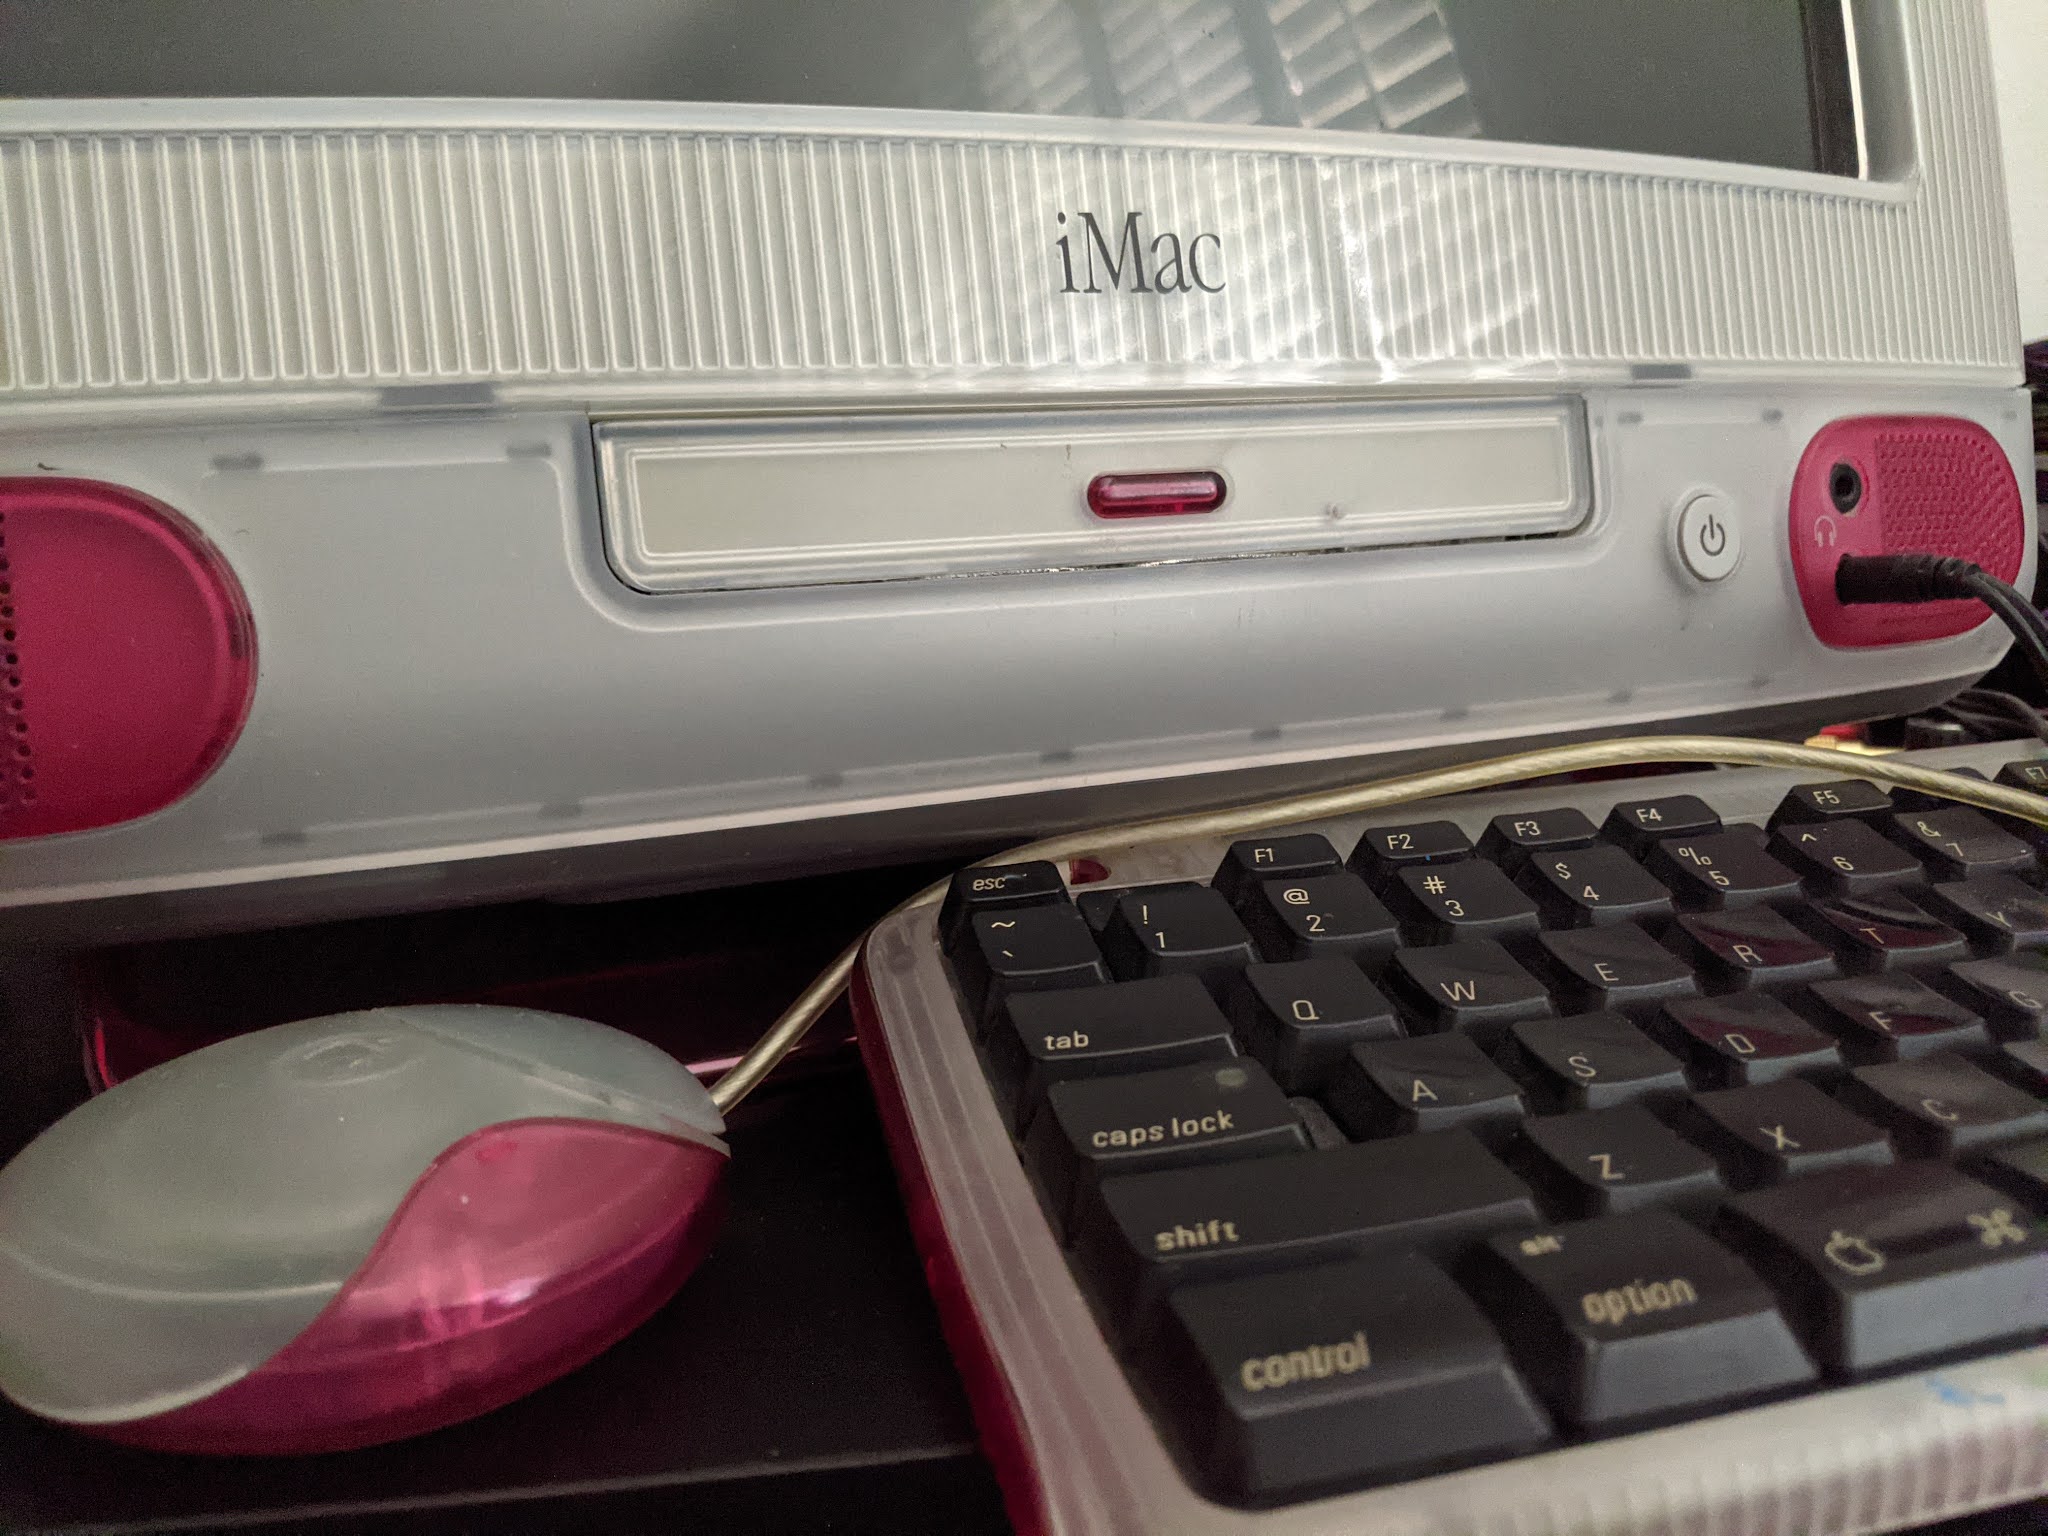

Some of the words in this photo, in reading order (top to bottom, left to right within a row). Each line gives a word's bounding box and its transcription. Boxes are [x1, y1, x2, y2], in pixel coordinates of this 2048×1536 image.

[1055, 211, 1227, 295] iMac
[1812, 789, 1841, 805] F5
[1635, 808, 1662, 823] F4
[1513, 820, 1541, 836] F3
[1386, 833, 1415, 850] F2
[1945, 842, 1964, 857] 7
[1254, 848, 1275, 863] F1
[1678, 847, 1713, 866] %
[1832, 856, 1854, 871] 6
[972, 876, 1006, 892] esc
[1423, 875, 1447, 895] #
[1708, 870, 1730, 886] 5
[1283, 888, 1311, 905] @
[1583, 885, 1600, 901] 4
[1445, 900, 1465, 917] 3
[1306, 914, 1325, 932] 2
[1986, 911, 2013, 928] Y
[1155, 931, 1166, 949] 1
[1859, 927, 1885, 945] T
[1733, 944, 1763, 963] R
[1594, 962, 1620, 982] E
[1440, 980, 1476, 1002] W
[2009, 991, 2043, 1010] G
[1292, 999, 1320, 1021] Q
[1868, 1011, 1892, 1031] F
[1043, 1030, 1090, 1051] tab
[1725, 1034, 1756, 1054] D
[1568, 1056, 1597, 1078] S
[1412, 1079, 1438, 1102] A
[1920, 1099, 1959, 1121] C
[1092, 1124, 1164, 1148] caps
[1171, 1109, 1235, 1139] lock
[1758, 1124, 1801, 1150] X
[1588, 1153, 1626, 1181] Z
[1154, 1219, 1240, 1251] shift
[1581, 1278, 1698, 1325] option
[1240, 1331, 1372, 1392] control
